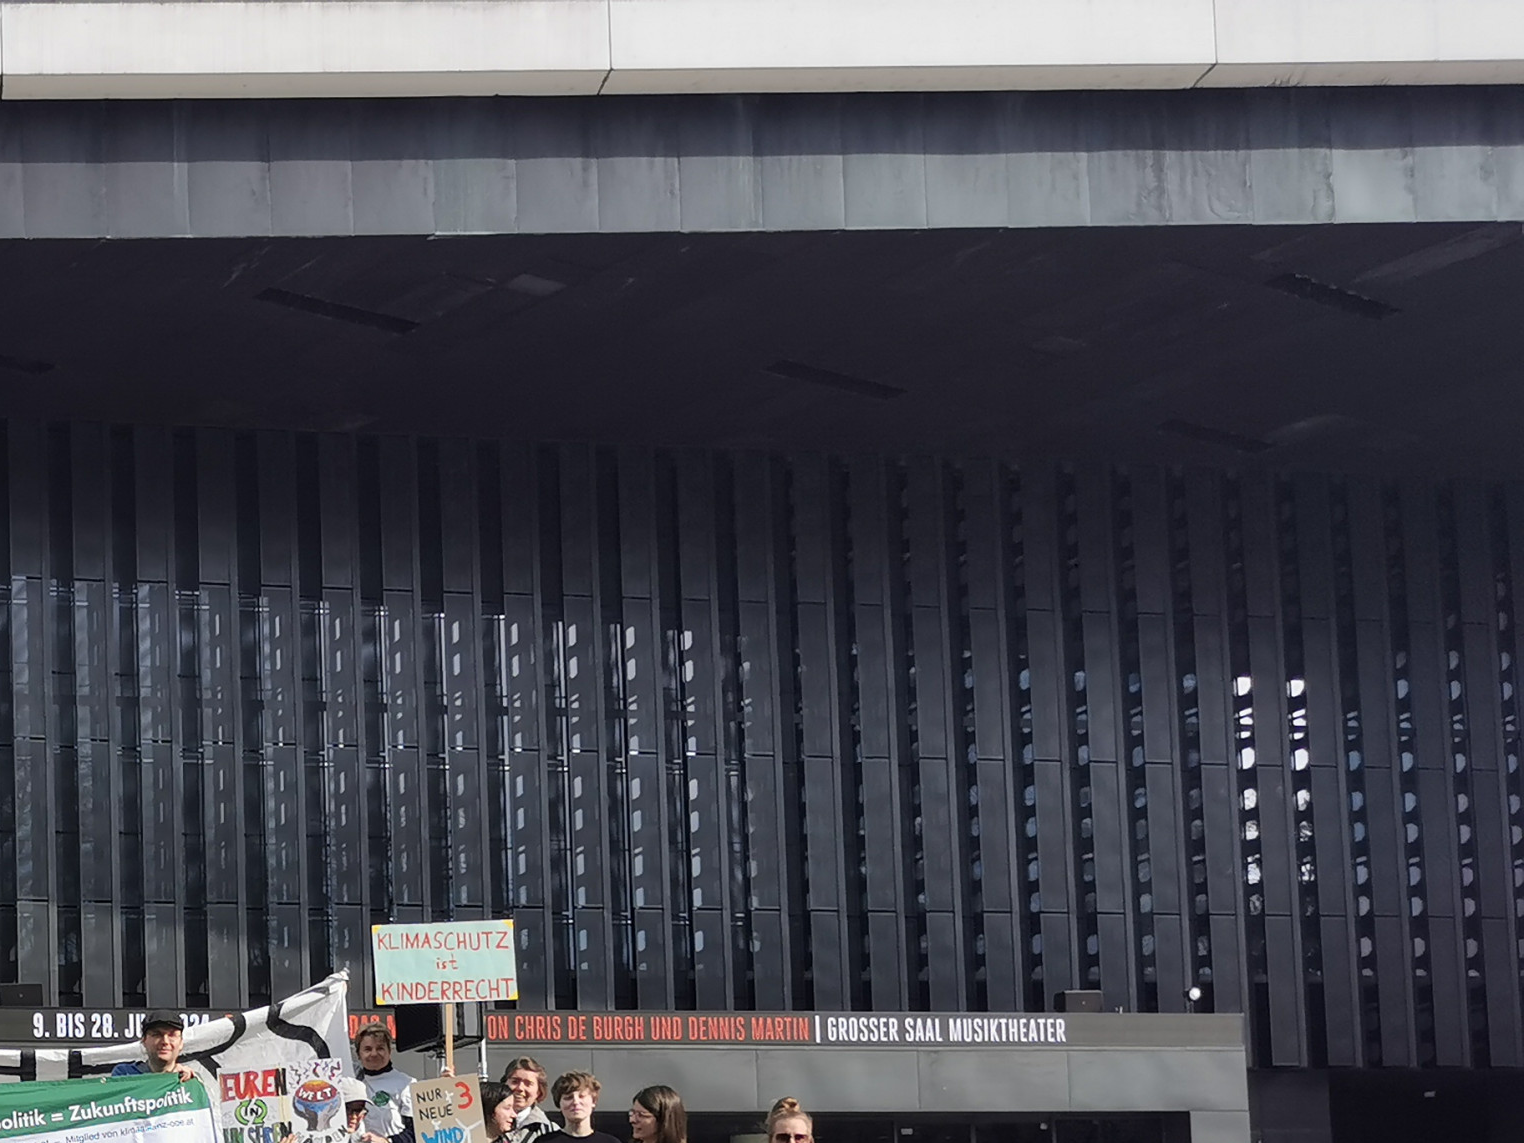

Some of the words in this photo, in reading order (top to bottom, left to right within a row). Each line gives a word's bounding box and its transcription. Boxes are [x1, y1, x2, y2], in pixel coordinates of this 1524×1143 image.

[377, 931, 509, 950] KLIMASCHUTZ
[436, 954, 458, 970] ist
[381, 978, 514, 1001] KINDERRECHT
[33, 1012, 50, 1038] 9.
[56, 1012, 85, 1038] BIS
[91, 1012, 118, 1038] 28.
[484, 1016, 509, 1040] ON
[515, 1015, 561, 1040] CHRIS
[568, 1015, 586, 1040] DE
[593, 1016, 644, 1040] BURGH
[650, 1016, 682, 1040] UND
[688, 1016, 745, 1041] DENNIS
[751, 1017, 809, 1041] MARTIN
[827, 1017, 899, 1042] GROSSER
[905, 1018, 943, 1042] SAAL
[949, 1018, 1066, 1043] MUSIKTHEATER
[298, 1087, 332, 1100] WELT
[416, 1088, 442, 1103] NUR
[455, 1081, 474, 1109] 3
[68, 1086, 194, 1123] Zukunftspolitik
[244, 1106, 259, 1116] IN
[418, 1103, 453, 1121] NEUE
[102, 1130, 118, 1140] von
